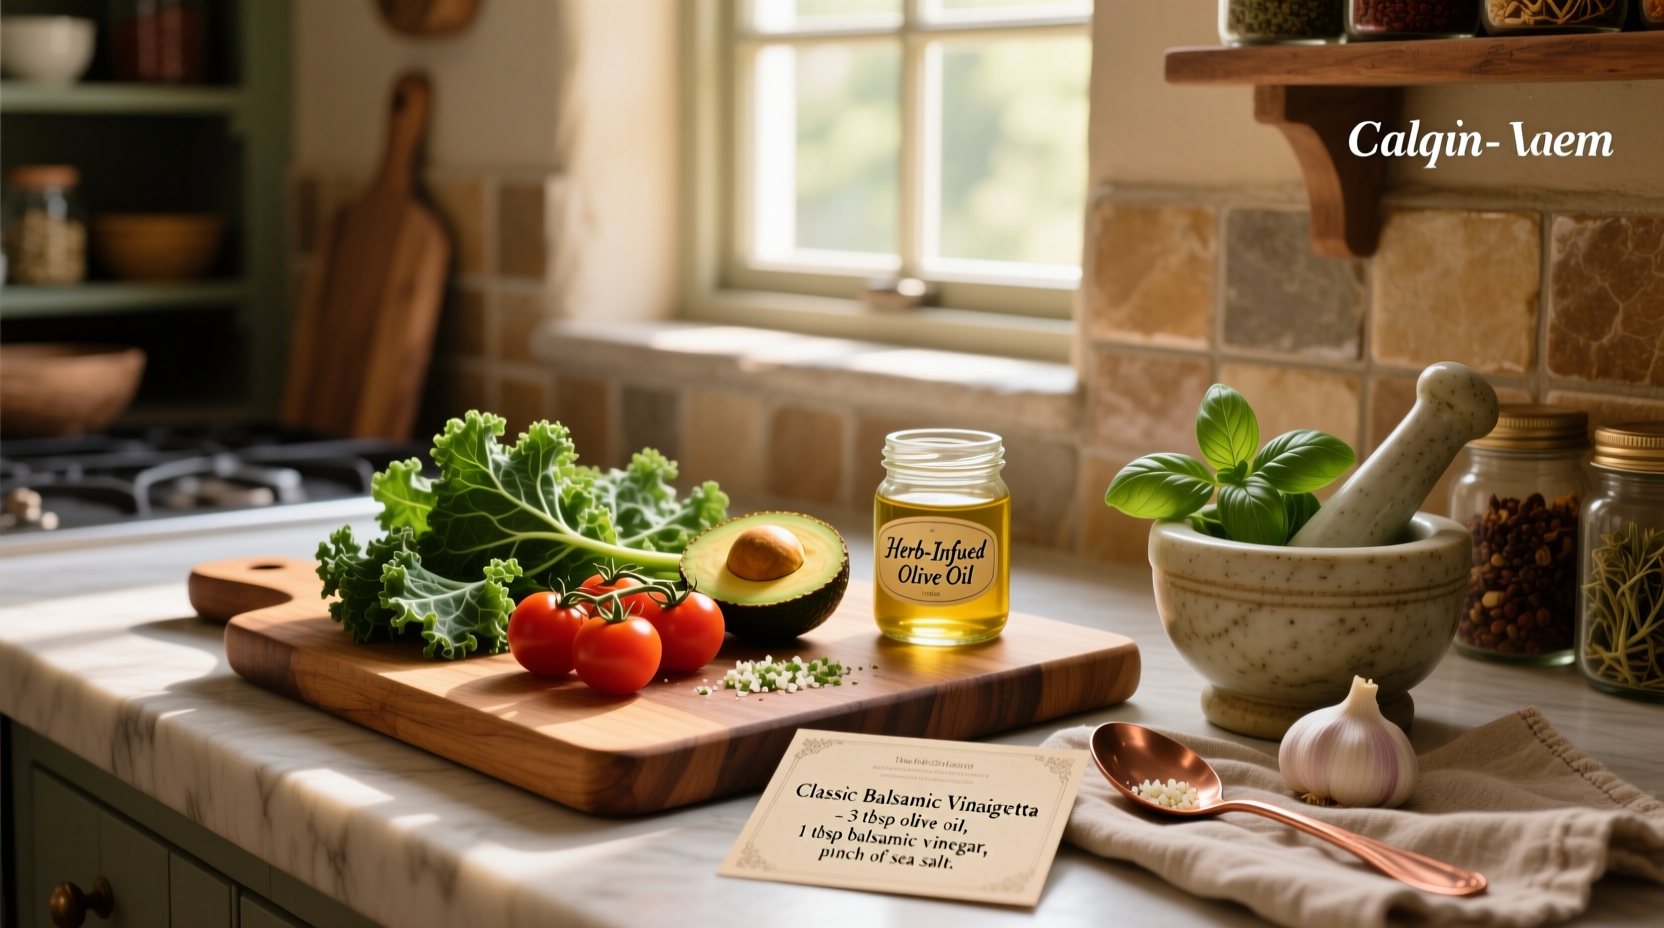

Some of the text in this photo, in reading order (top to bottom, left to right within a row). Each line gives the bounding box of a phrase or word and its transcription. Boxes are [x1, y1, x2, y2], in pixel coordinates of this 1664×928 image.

[884, 536, 988, 568] Herb-Infued
[898, 564, 975, 586] Olive Oil
[796, 783, 858, 802] Classic
[863, 788, 942, 809] Balsamic
[847, 809, 859, 823] 3
[862, 809, 896, 830] tbsp
[900, 812, 938, 830] olive
[943, 817, 968, 836] oil,
[811, 824, 843, 845] tbsp
[847, 827, 918, 848] balsamic
[923, 836, 988, 858] vinegar,
[818, 846, 865, 862] pinch
[869, 849, 890, 864] of
[889, 854, 915, 867] sea
